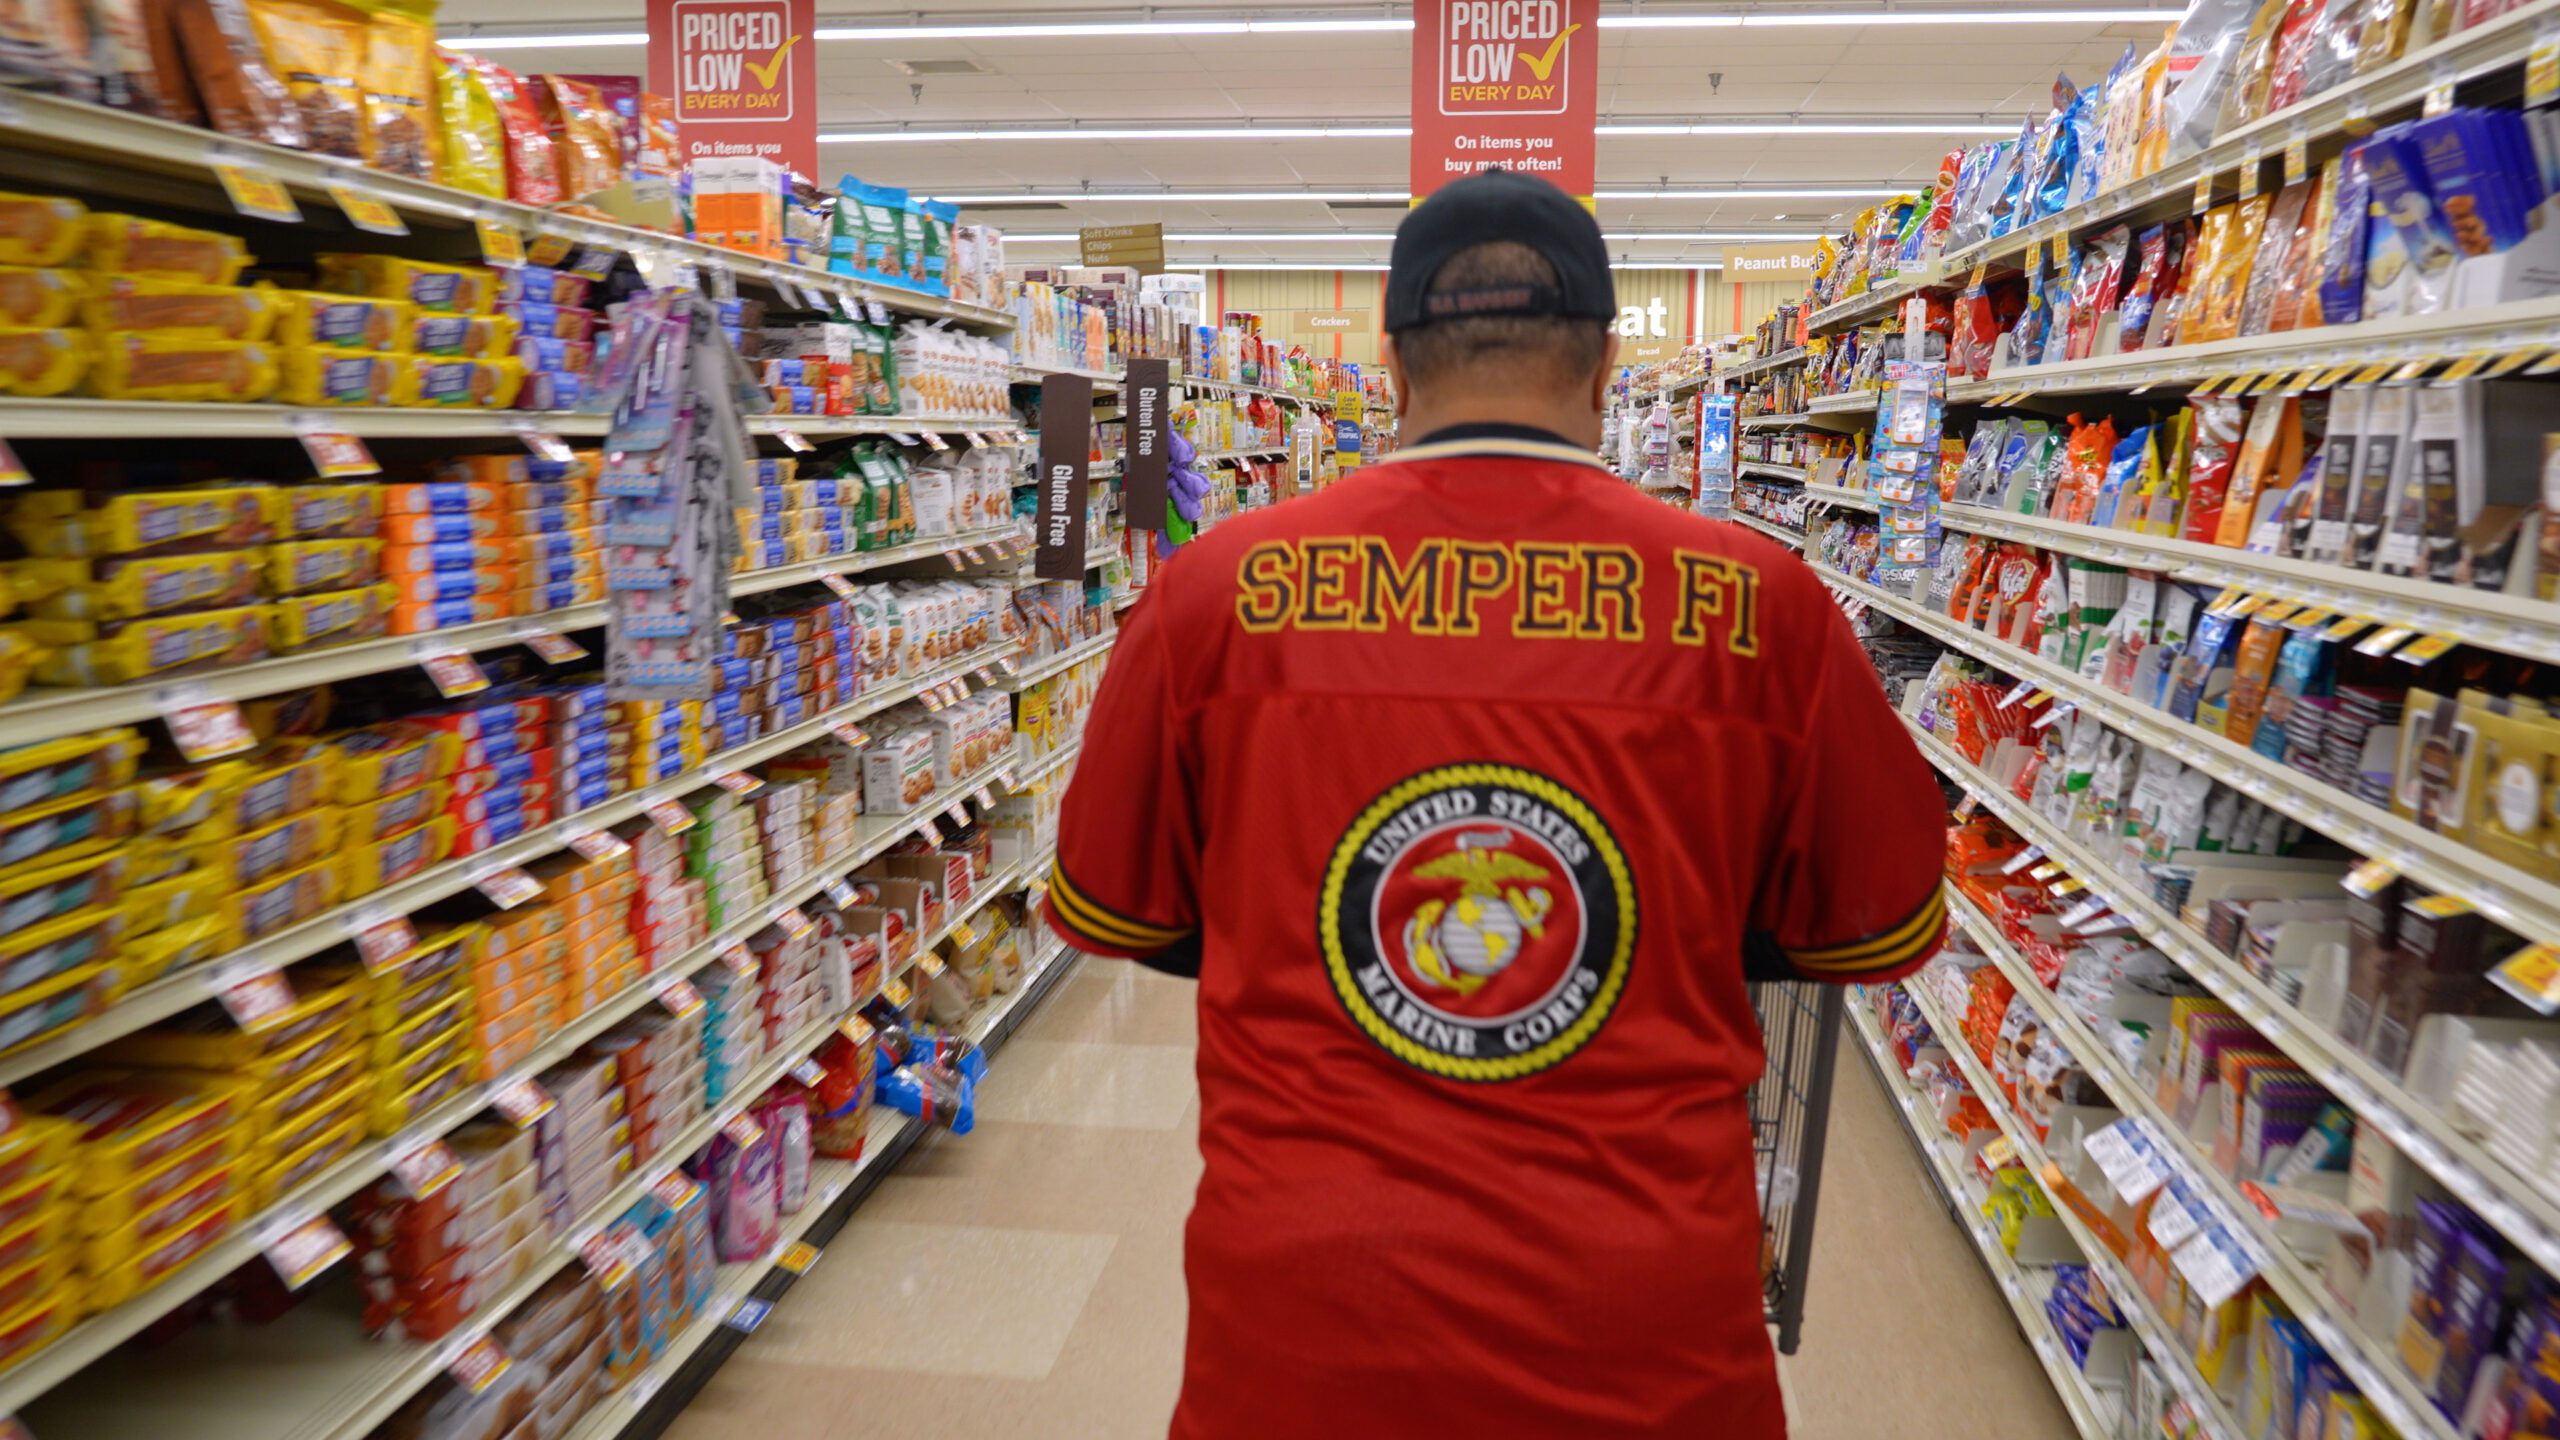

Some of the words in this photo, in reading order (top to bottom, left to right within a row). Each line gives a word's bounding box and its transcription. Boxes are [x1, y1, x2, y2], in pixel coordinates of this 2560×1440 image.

[682, 11, 782, 51] PRICED
[1451, 0, 1558, 40] PRICED
[683, 53, 744, 92] LOW
[1450, 43, 1516, 83] LOW
[684, 93, 742, 110] EVERY
[745, 92, 782, 109] DAY
[1450, 85, 1511, 101] EVERY
[1517, 84, 1556, 100] DAY
[690, 140, 713, 156] On
[714, 140, 753, 155] items
[755, 142, 782, 157] you
[1454, 135, 1477, 149] On
[1480, 134, 1522, 149] items
[1525, 137, 1553, 152] you
[1444, 157, 1472, 174] buy
[1516, 156, 1562, 171] often!
[1083, 228, 1102, 239] Soft
[1103, 227, 1134, 237] Drinks
[1087, 241, 1112, 252] Chips
[1087, 254, 1109, 264] Nuts
[1733, 256, 1787, 271] Peanut
[1311, 316, 1352, 327] Crackers
[1637, 346, 1660, 357] Bread
[1138, 387, 1158, 428] Gluten
[1138, 429, 1157, 456] Free
[1050, 464, 1074, 513] Gluten
[1049, 515, 1072, 547] Free
[1236, 535, 1644, 641] SEMPER
[1671, 547, 1759, 658] FI
[1362, 789, 1477, 866] UNITED
[1489, 790, 1590, 866] STATES
[1357, 962, 1477, 1056] MARINE
[1503, 967, 1599, 1053] CORPS
